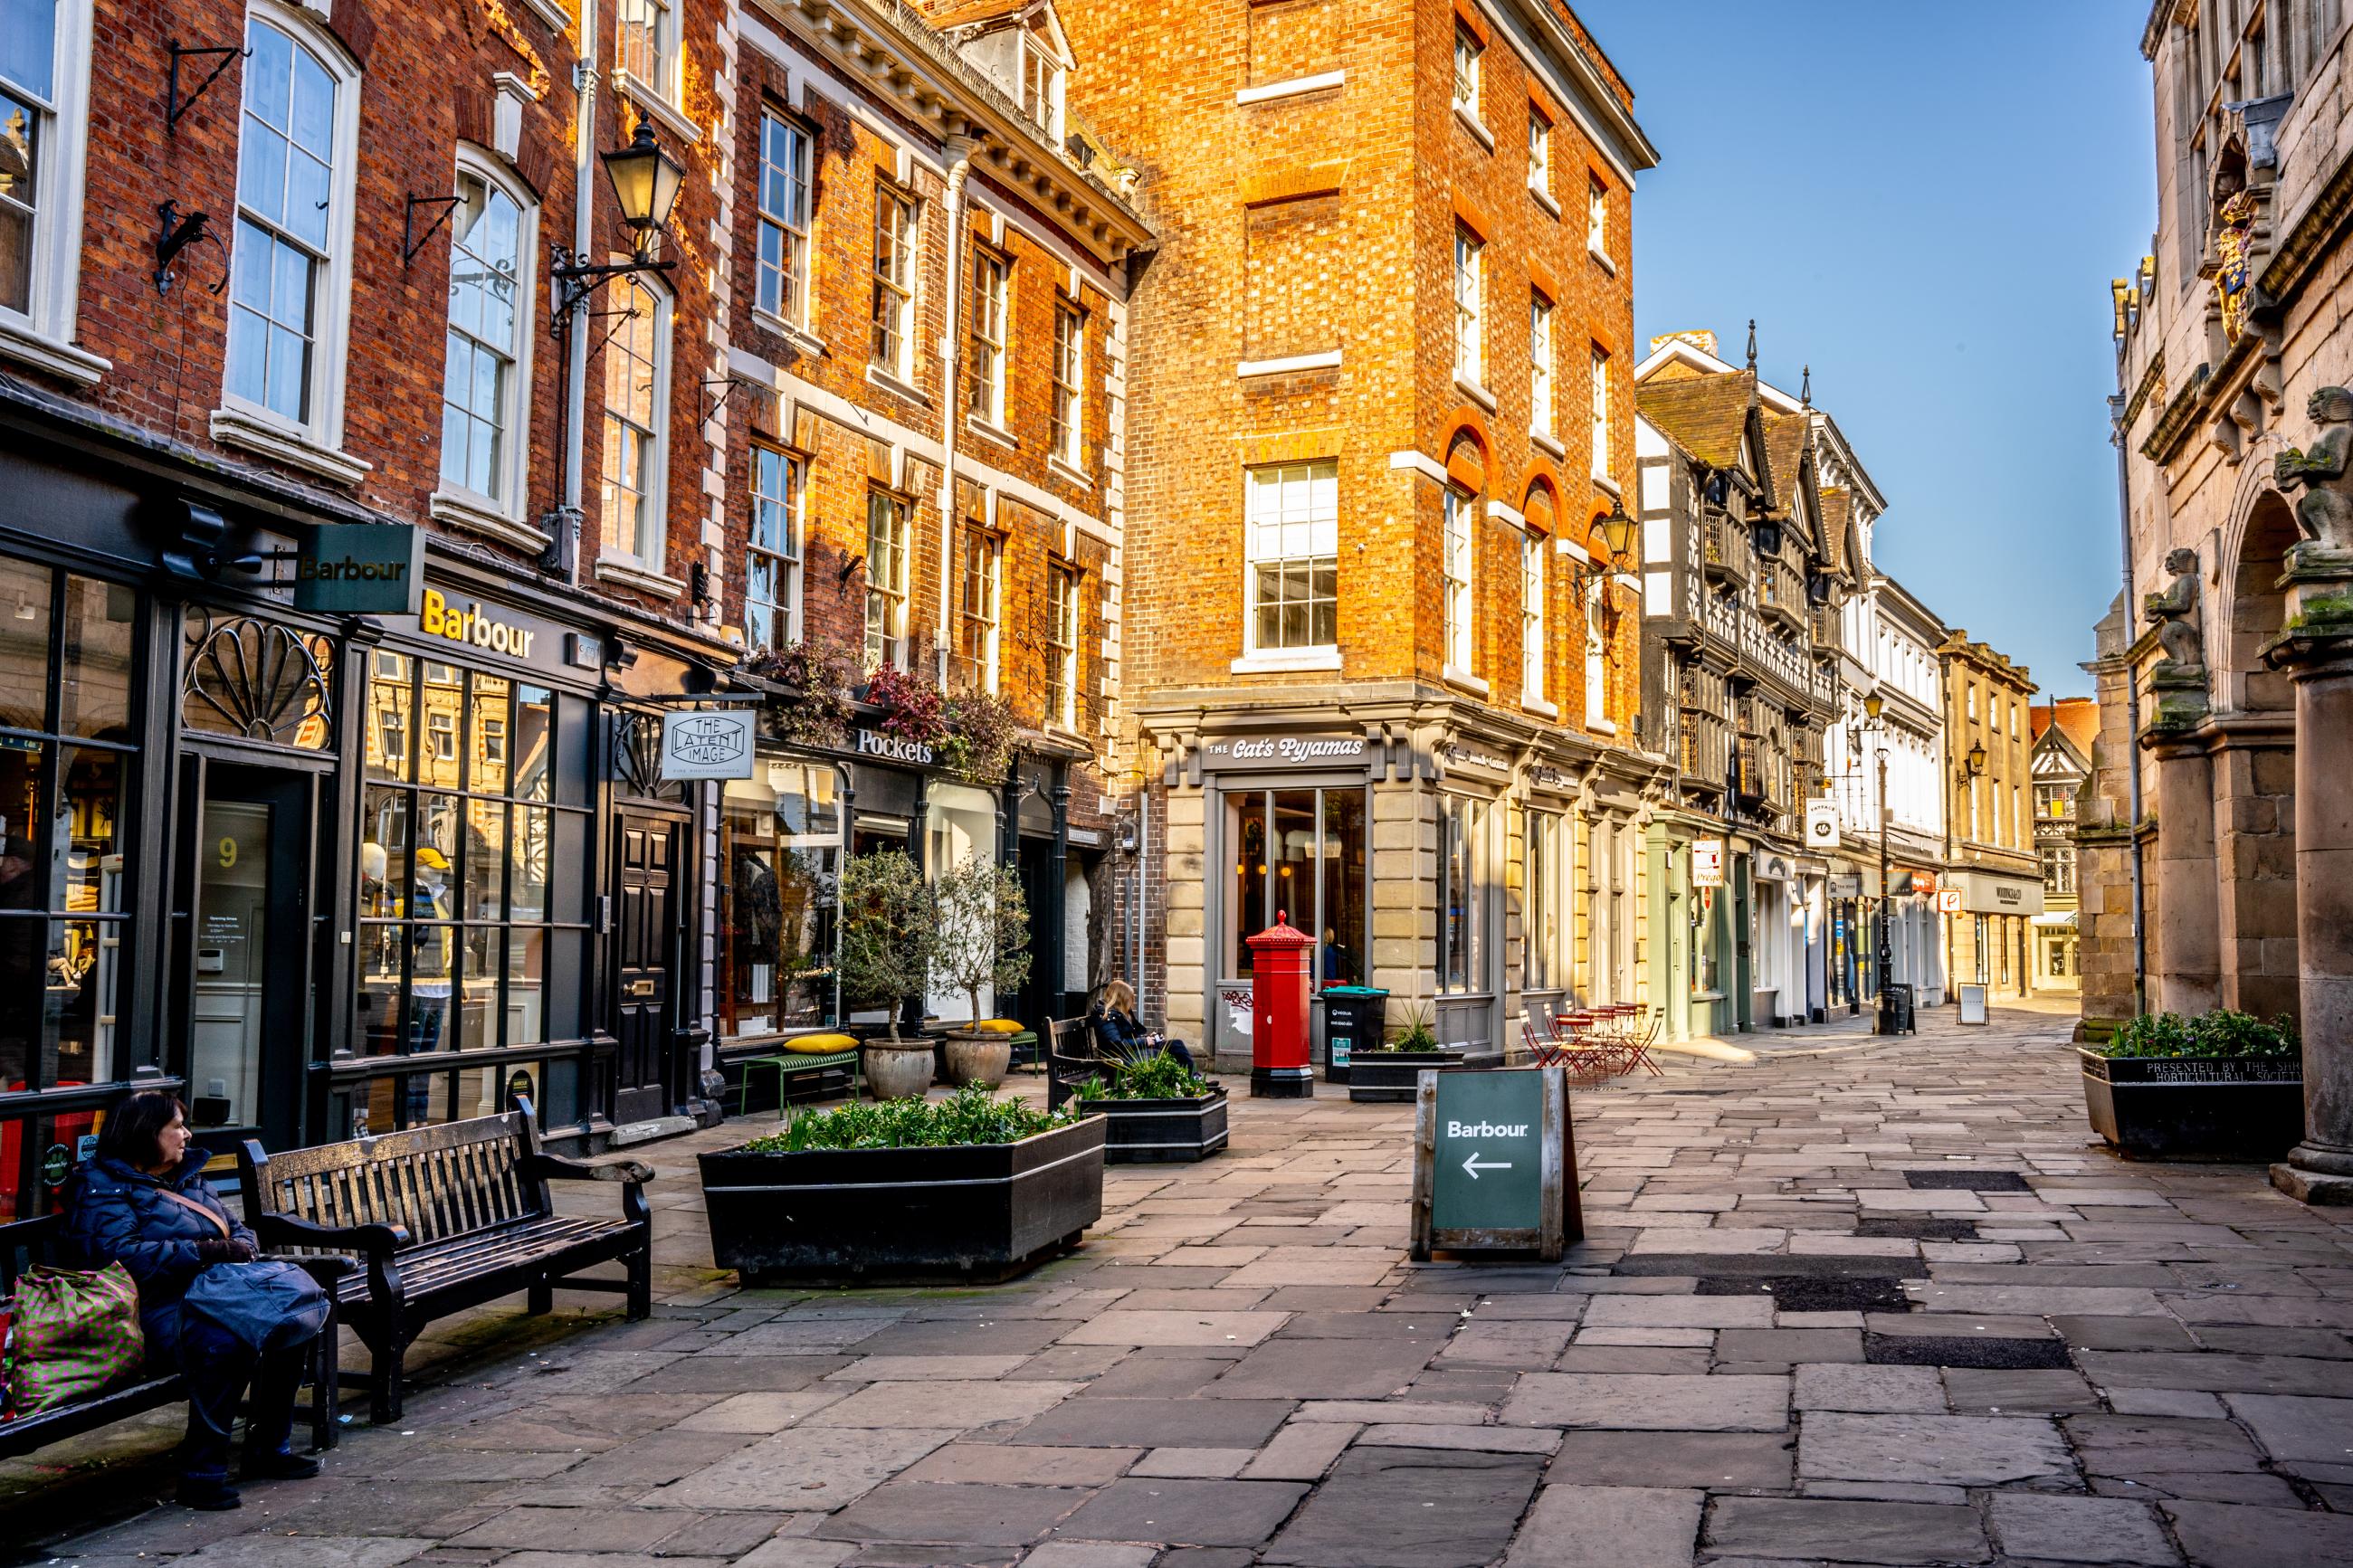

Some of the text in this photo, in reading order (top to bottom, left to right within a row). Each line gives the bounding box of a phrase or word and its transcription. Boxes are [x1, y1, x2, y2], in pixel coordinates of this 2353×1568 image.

[300, 555, 406, 582] Barbour
[423, 588, 534, 659] Barbour
[696, 719, 721, 734] THE
[674, 729, 741, 750] LATENT
[857, 728, 932, 764] Pockets
[689, 746, 725, 762] IMAGE
[1208, 737, 1364, 763] THE Cat's Pyjamas
[219, 837, 237, 868] 9
[1697, 873, 1721, 883] Prego
[2147, 1061, 2302, 1073] PRESENTED BY THE SHR
[2157, 1072, 2302, 1082] HORTICULTURAL SOCIETY
[1447, 1120, 1529, 1138] Barbour
